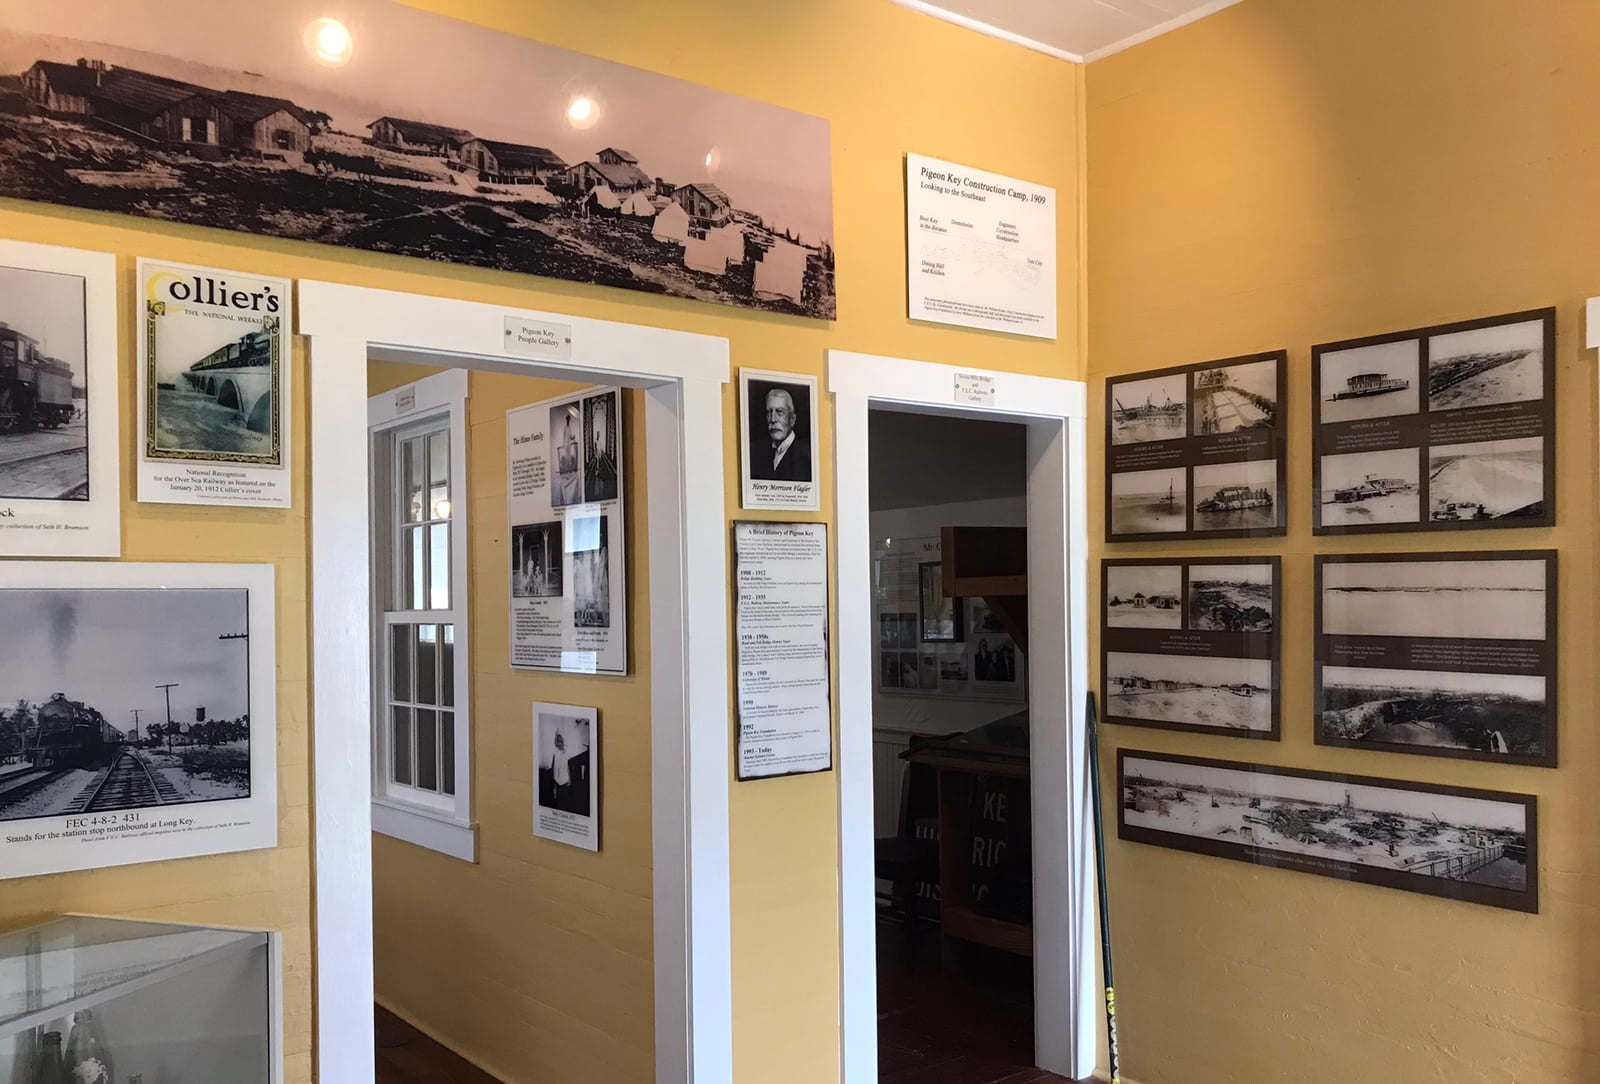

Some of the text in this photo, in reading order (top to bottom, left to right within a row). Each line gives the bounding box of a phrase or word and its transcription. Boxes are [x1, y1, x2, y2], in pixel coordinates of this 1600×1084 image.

[920, 167, 1046, 204] Pigeon Key Construction Camp, 1909
[920, 181, 944, 194] Looking
[952, 188, 960, 196] the
[961, 190, 986, 202] Southeast
[184, 309, 199, 317] THE
[202, 311, 235, 321] NATIONAL
[522, 327, 554, 338] Pigeon Key
[518, 335, 559, 348] People Gallery
[212, 470, 246, 478] Recognition
[170, 484, 192, 492] January
[203, 478, 226, 486] Railway
[66, 813, 140, 828] FEC 4-8-2 431
[6, 834, 32, 844] Stands
[34, 832, 46, 840] for
[62, 829, 87, 837] station
[89, 827, 105, 836] stop
[106, 822, 149, 832] northbound
[159, 819, 177, 828] Long
[179, 818, 196, 826] Key.
